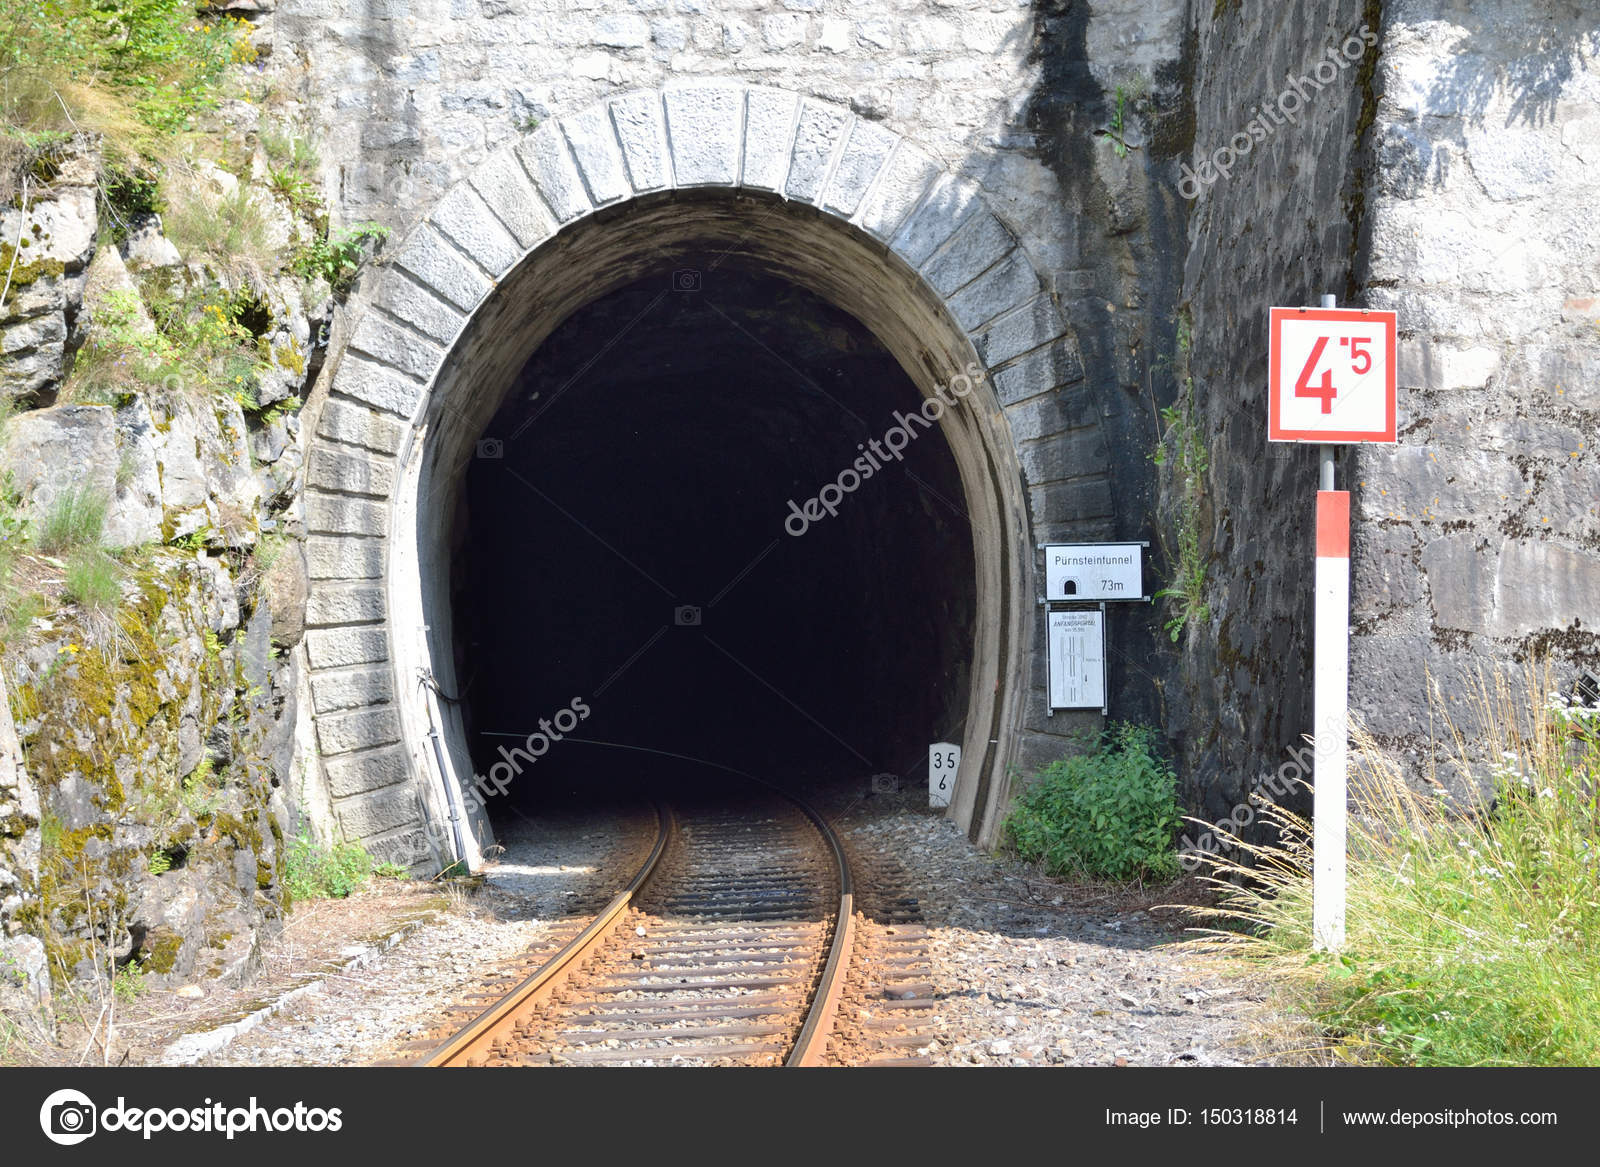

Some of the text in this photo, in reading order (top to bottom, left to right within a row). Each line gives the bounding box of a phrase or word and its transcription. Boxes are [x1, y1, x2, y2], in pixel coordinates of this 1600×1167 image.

[1055, 555, 1132, 566] Pürnsteintunnel
[1101, 580, 1124, 591] 73m
[939, 774, 947, 790] 6
